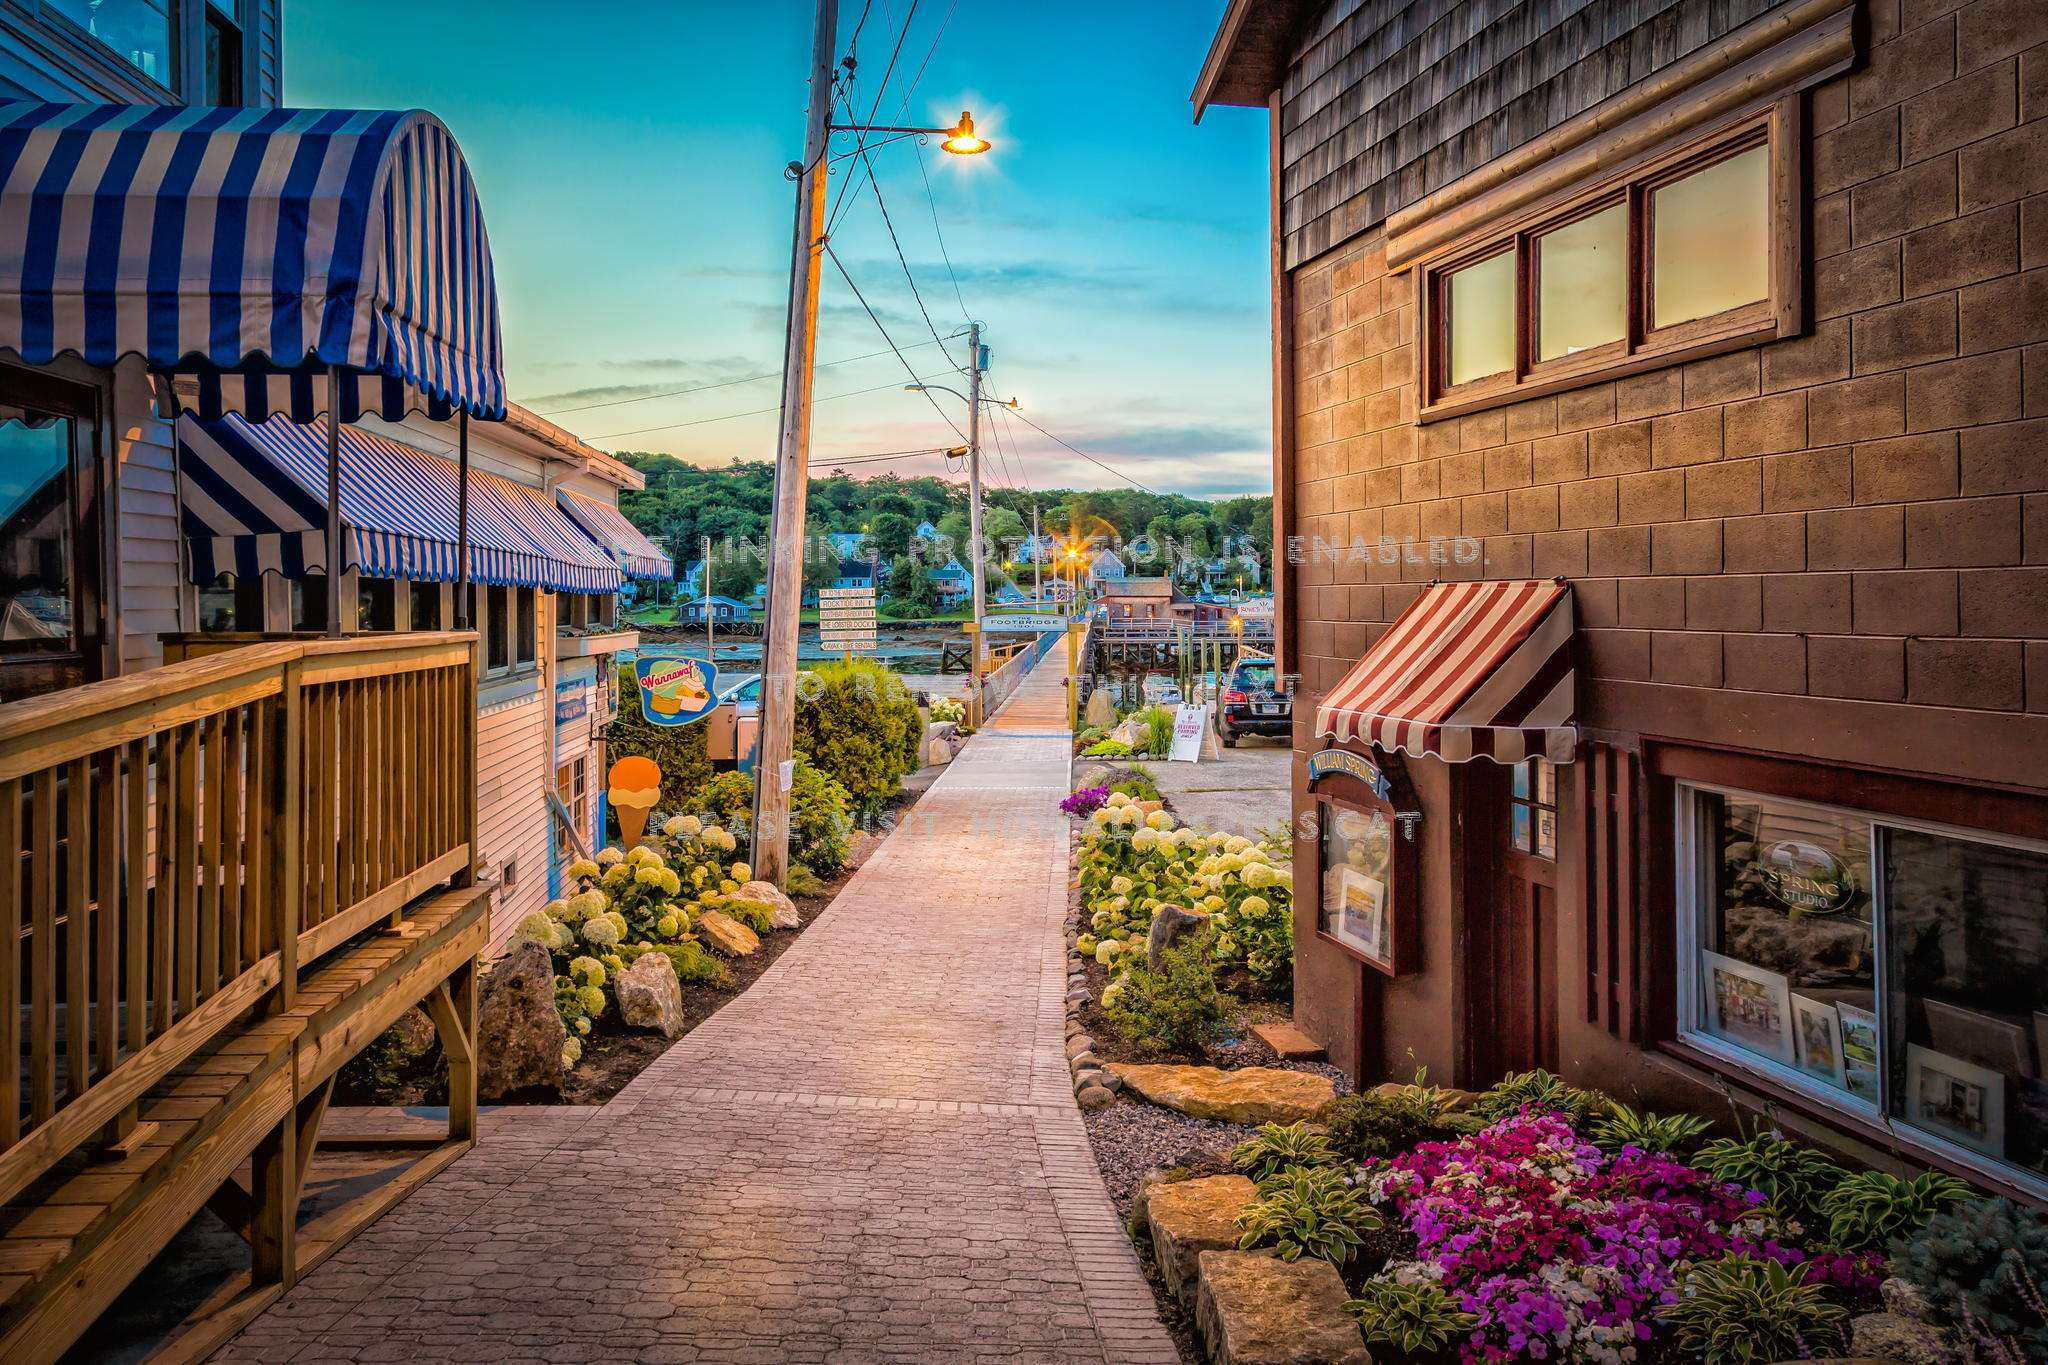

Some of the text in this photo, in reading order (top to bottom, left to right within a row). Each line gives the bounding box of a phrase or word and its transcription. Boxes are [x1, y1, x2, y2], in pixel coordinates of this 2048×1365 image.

[640, 660, 695, 689] Wannawaf
[1313, 752, 1377, 784] WILLIAM SPRING
[1766, 870, 1840, 897] SPRING
[1782, 888, 1829, 909] STUDIO
